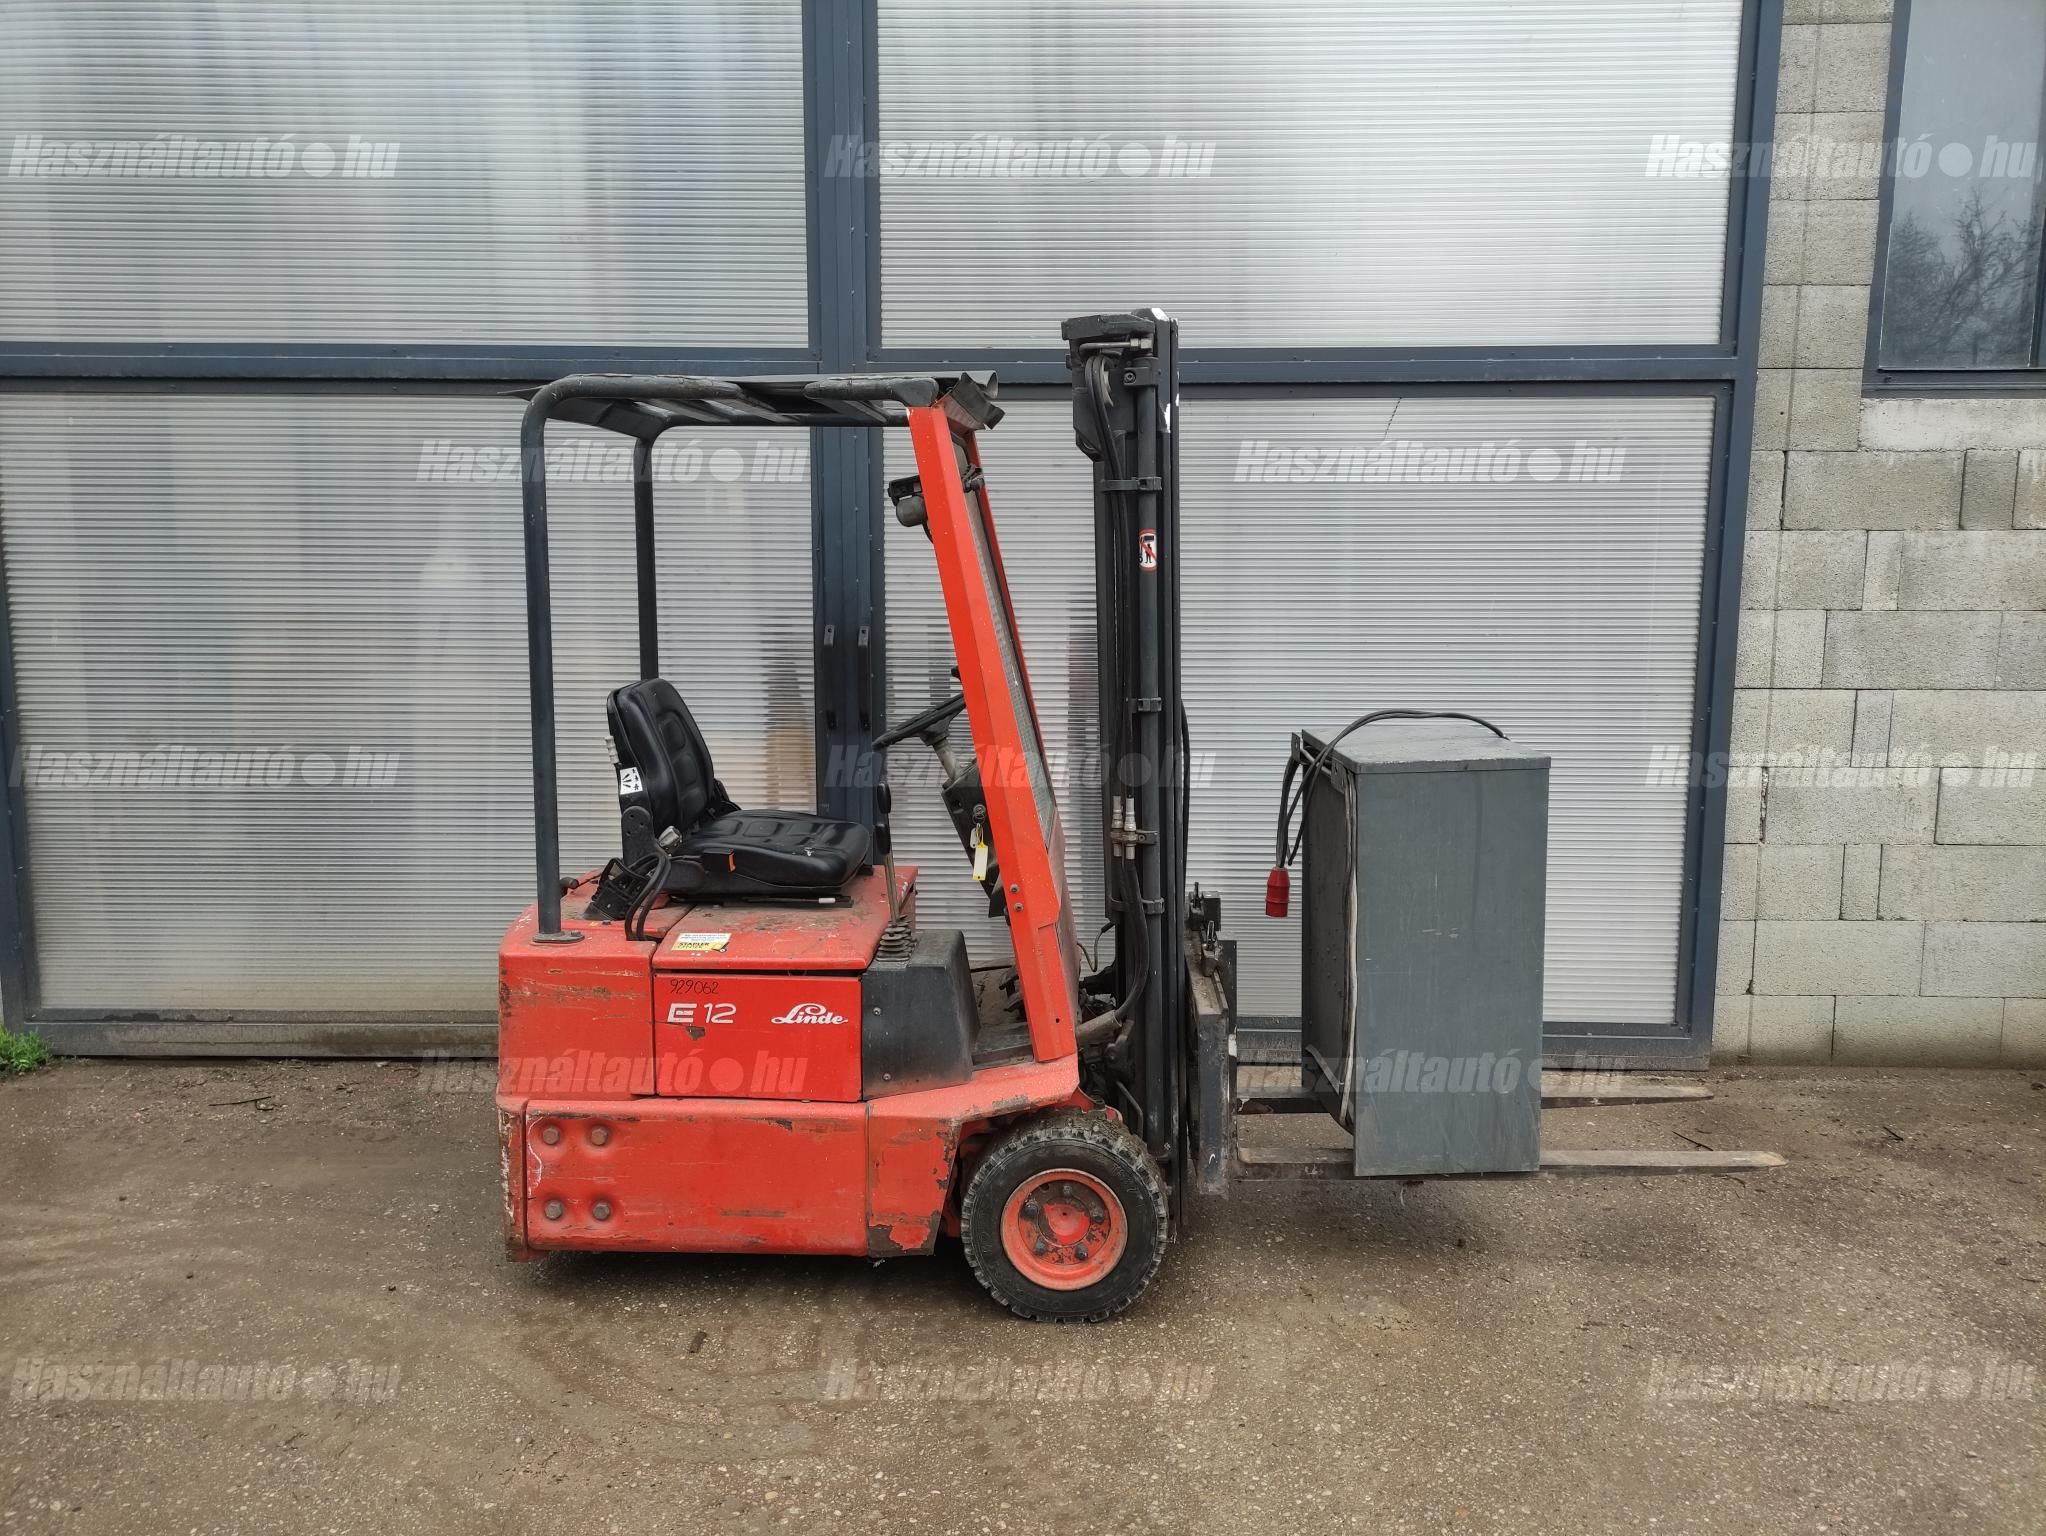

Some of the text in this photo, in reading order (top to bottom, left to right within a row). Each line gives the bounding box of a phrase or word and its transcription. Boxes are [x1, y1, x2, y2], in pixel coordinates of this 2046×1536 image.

[670, 979, 719, 995] 929062
[667, 1003, 736, 1024] E 12
[771, 1003, 848, 1025] Linde
